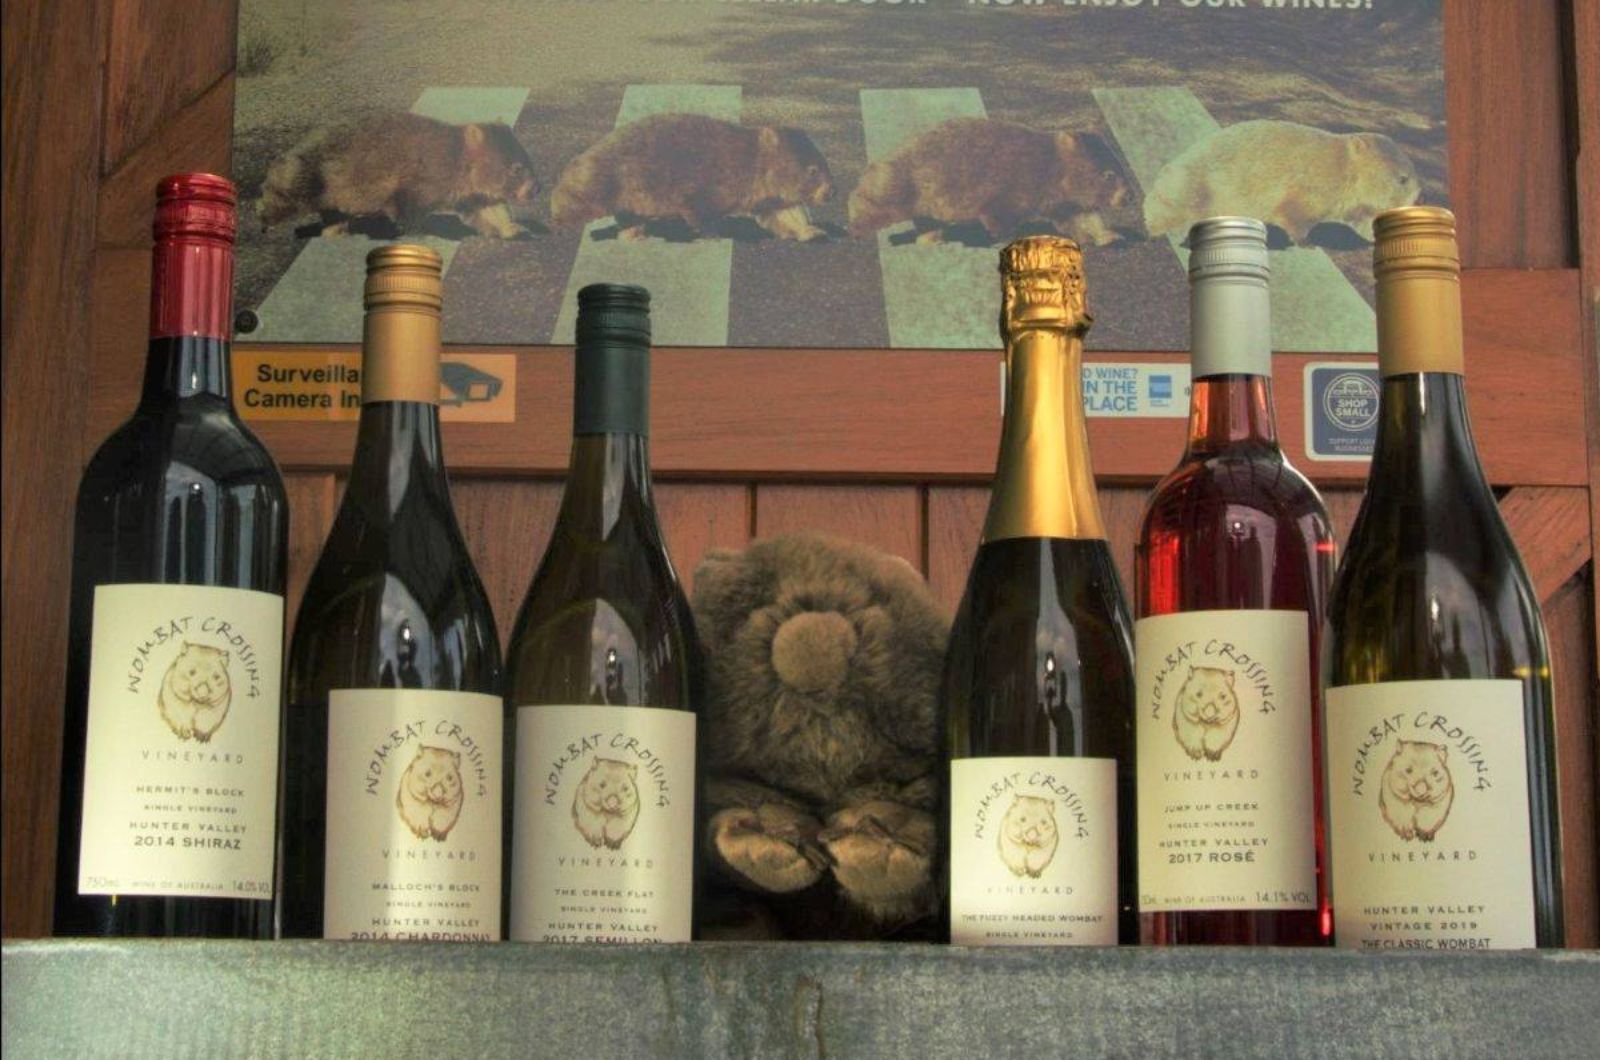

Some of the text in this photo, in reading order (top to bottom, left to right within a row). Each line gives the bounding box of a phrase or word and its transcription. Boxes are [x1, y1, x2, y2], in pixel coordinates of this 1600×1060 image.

[257, 364, 360, 383] Surveilla
[1095, 367, 1138, 379] WINE?
[1103, 380, 1137, 394] THE
[244, 389, 332, 408] Camera
[1337, 398, 1369, 408] SHOP
[1335, 407, 1371, 417] SMALL
[128, 616, 261, 699] WOMBAT CROSSING
[1151, 639, 1276, 720] WOMBAT CROSSING
[142, 751, 244, 764] VINEYARD
[364, 720, 491, 797] WOMBAT CROSSING
[1353, 711, 1491, 796] WOMBAT CROSSING
[545, 733, 670, 808] WOMBAT CROSSING
[1164, 769, 1259, 782] VINEYARD
[136, 785, 246, 798] HERMIT'S BLOCK
[974, 771, 1089, 840] WOMBAT CROSSING
[1164, 803, 1260, 814] JUMP UP CREEK
[129, 821, 247, 834] HUNTER VALLEY
[134, 835, 242, 851] 2014 SHIRAZ
[1158, 837, 1269, 848] HUNTER VALLEY
[382, 850, 477, 861] VINEYARD
[1169, 850, 1256, 864] 2017 ROSÉ
[1368, 851, 1477, 862] VINEYARD
[558, 857, 654, 868] VINEYARD
[554, 888, 654, 898] THE CREEK FLAT
[987, 886, 1073, 895] VINEYARD
[1363, 905, 1486, 915] HUNTER VALLEY
[371, 918, 480, 928] HUNTER VALLEY
[1059, 914, 1103, 924] WOMBAT
[548, 922, 659, 933] HUNTER VALLEY
[1370, 921, 1478, 931] VINTAGE 2019
[1437, 938, 1491, 949] WOMBAT
